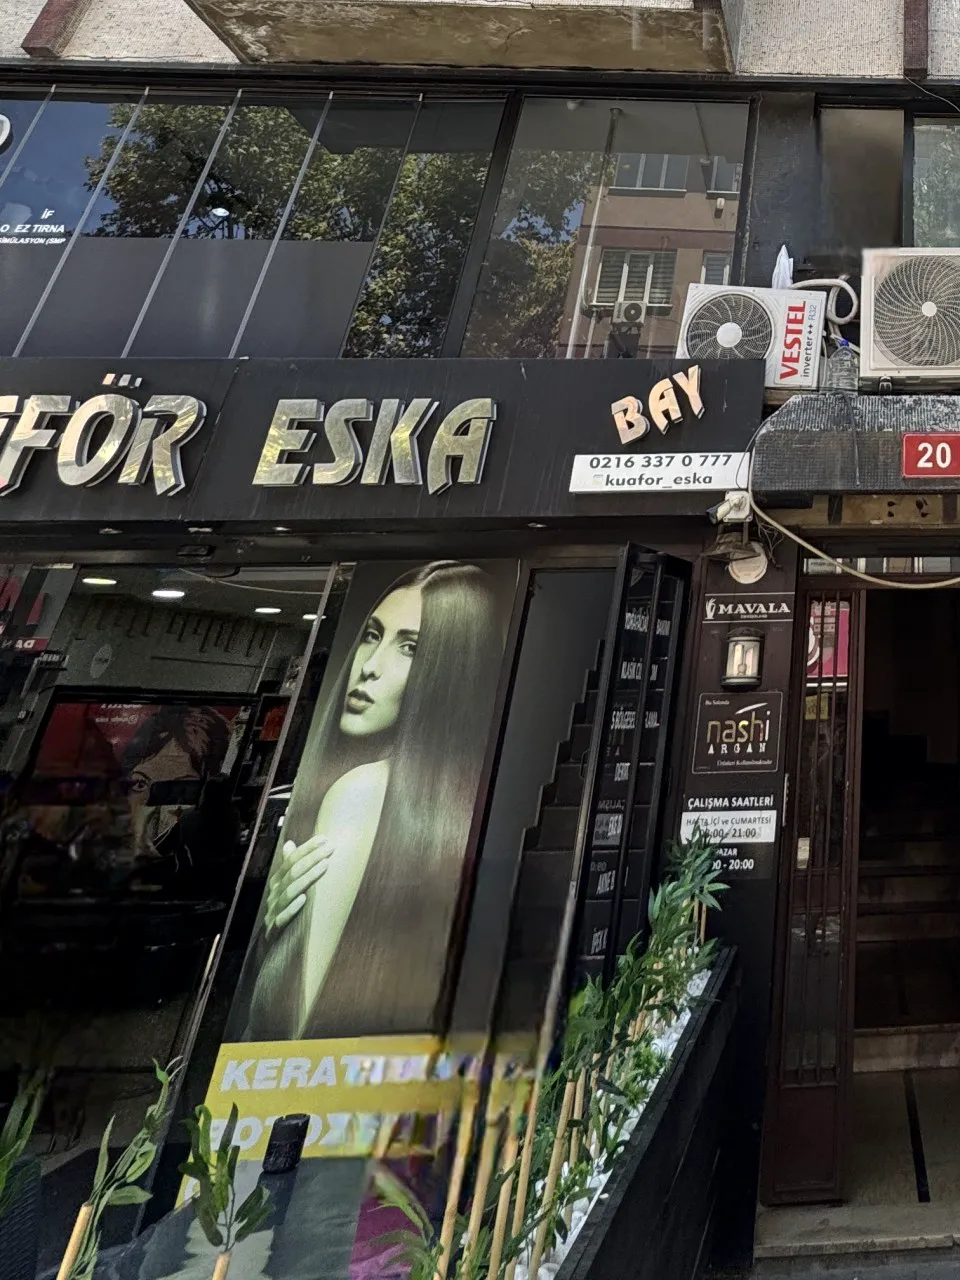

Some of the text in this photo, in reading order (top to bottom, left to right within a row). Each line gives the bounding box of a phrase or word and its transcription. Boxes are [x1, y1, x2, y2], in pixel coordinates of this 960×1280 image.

[779, 300, 806, 380] VESTEL
[611, 364, 705, 445] BAY
[251, 398, 497, 496] ESKA
[589, 454, 733, 469] 0216 337 0 777
[916, 442, 952, 469] 20
[605, 472, 713, 489] kuafor_eska
[718, 602, 791, 614] MAVALA
[706, 710, 771, 743] nashi
[708, 742, 767, 754] ARGAN
[688, 795, 774, 810] ÇALIŞMA SAATLERİ
[730, 816, 772, 824] CUMARTESİ
[731, 827, 757, 837] 21:00
[716, 847, 738, 856] AZAR
[728, 858, 755, 870] 20:00
